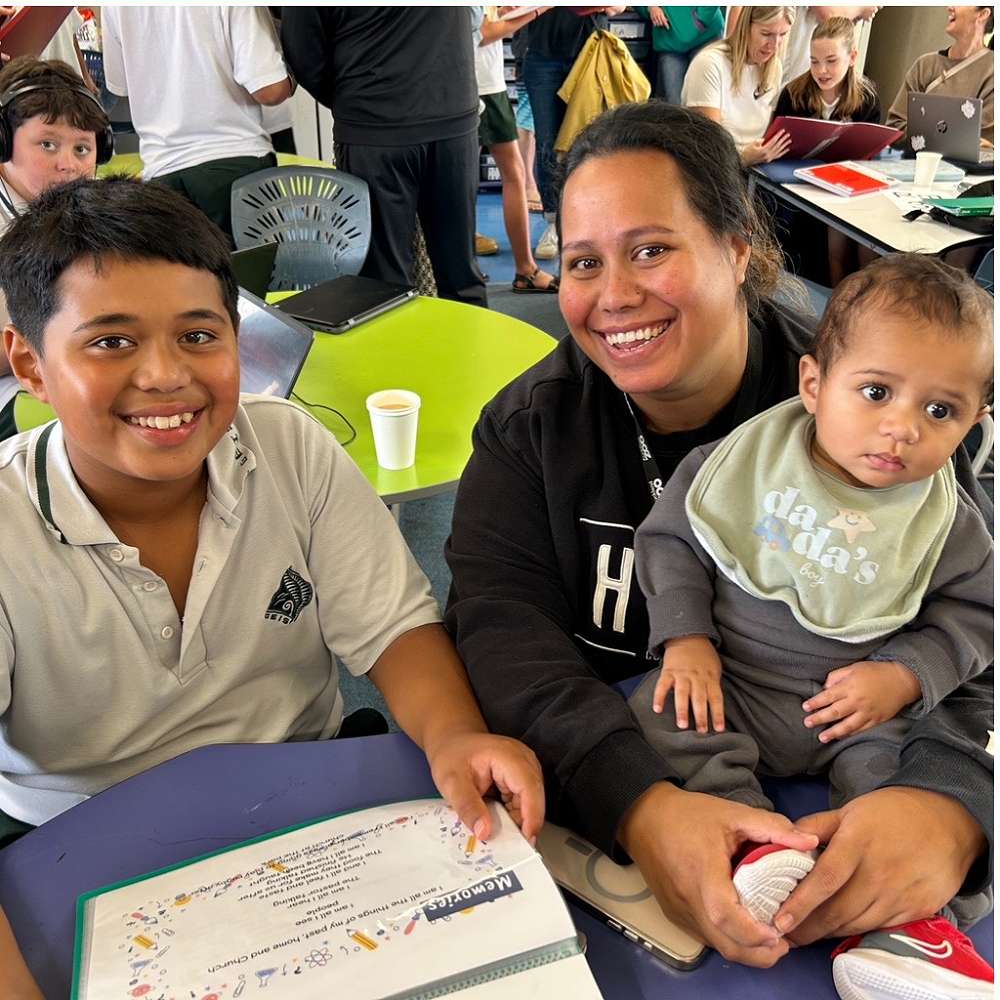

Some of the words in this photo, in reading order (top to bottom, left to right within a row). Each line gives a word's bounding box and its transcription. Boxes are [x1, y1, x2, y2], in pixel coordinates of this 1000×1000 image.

[763, 486, 816, 532] da
[792, 529, 879, 585] da's
[592, 544, 634, 633] H
[264, 612, 290, 625] GEIS
[272, 892, 304, 907] talking
[429, 875, 512, 913] Memories
[356, 903, 388, 919] things
[272, 936, 300, 950] home
[250, 947, 270, 958] and
[206, 954, 248, 973] Church
